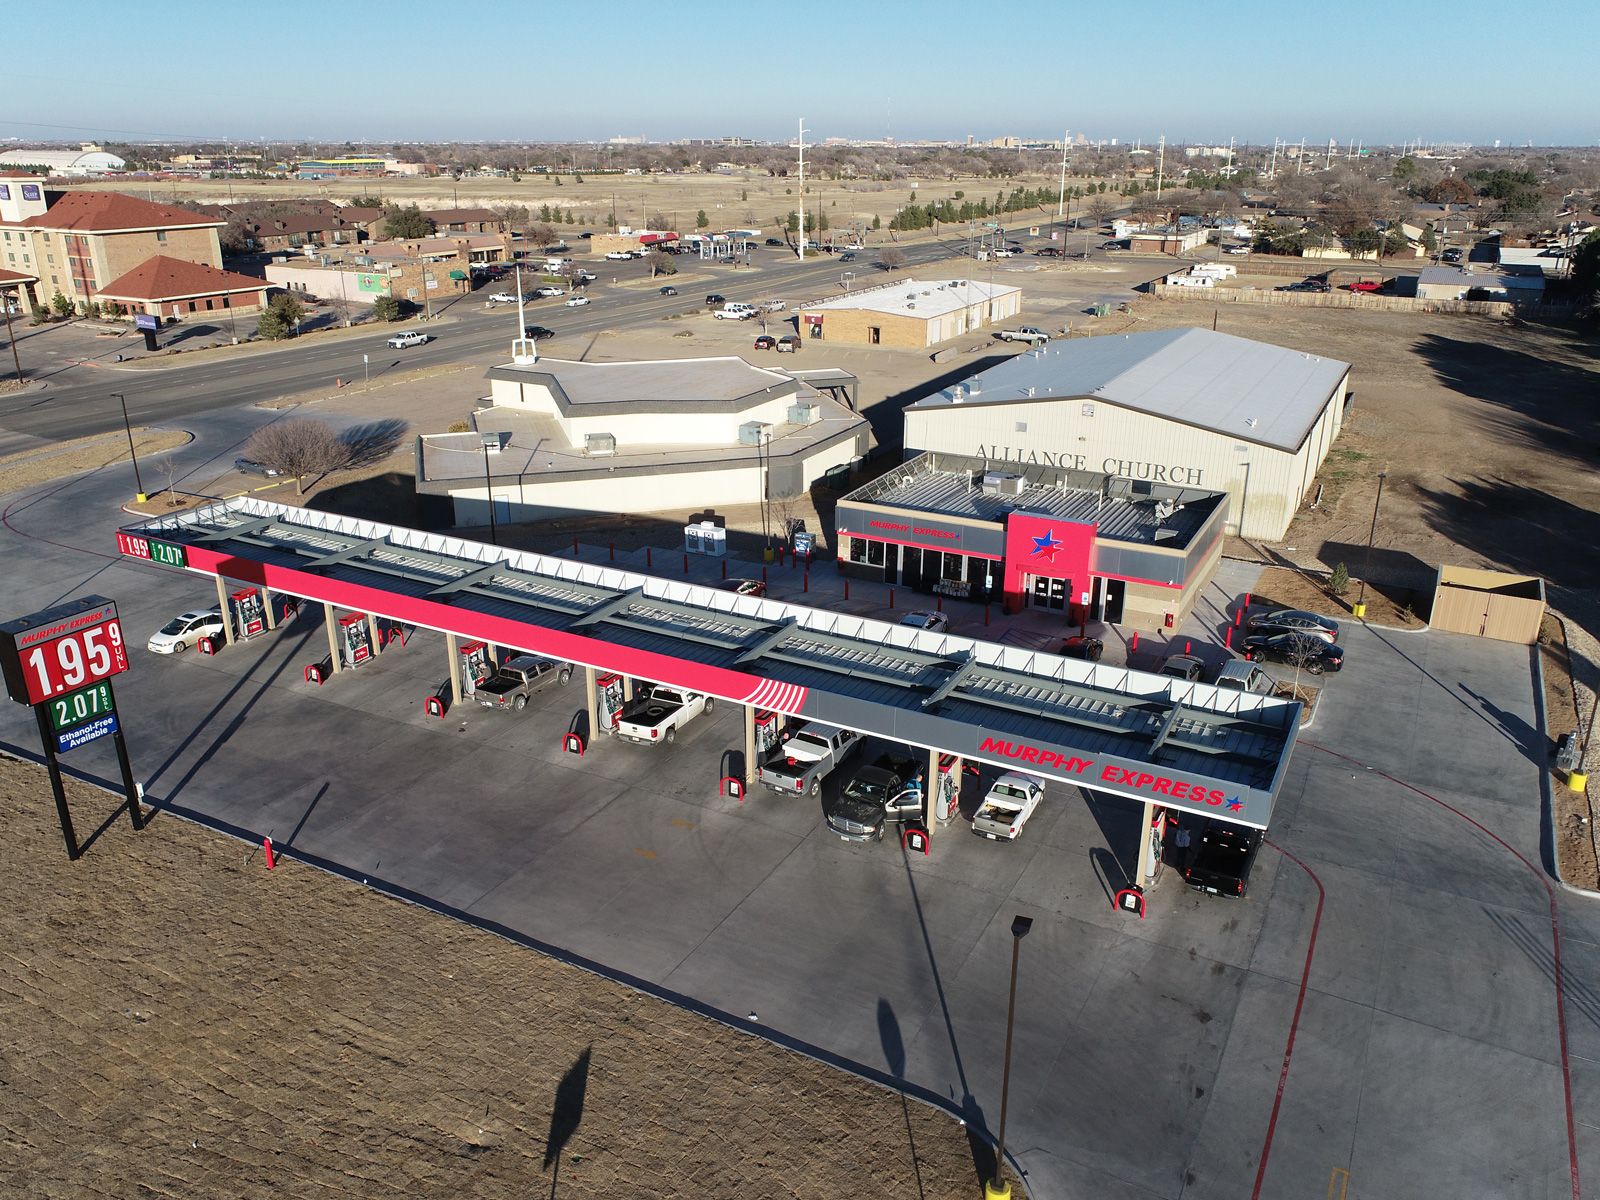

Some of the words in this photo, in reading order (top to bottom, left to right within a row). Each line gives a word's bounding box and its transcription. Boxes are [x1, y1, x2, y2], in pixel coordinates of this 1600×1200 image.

[975, 443, 1087, 471] ALLIANCE
[1102, 458, 1204, 486] CHURCH
[869, 520, 911, 533] MURPHY
[913, 527, 955, 539] EXPRESS
[21, 621, 68, 645] MURPHY
[69, 610, 103, 629] EXPRESS
[59, 717, 113, 744] Ethanol-Free
[70, 727, 108, 748] Available
[978, 737, 1095, 775] MURPHY
[1100, 765, 1226, 807] EXPRESS
